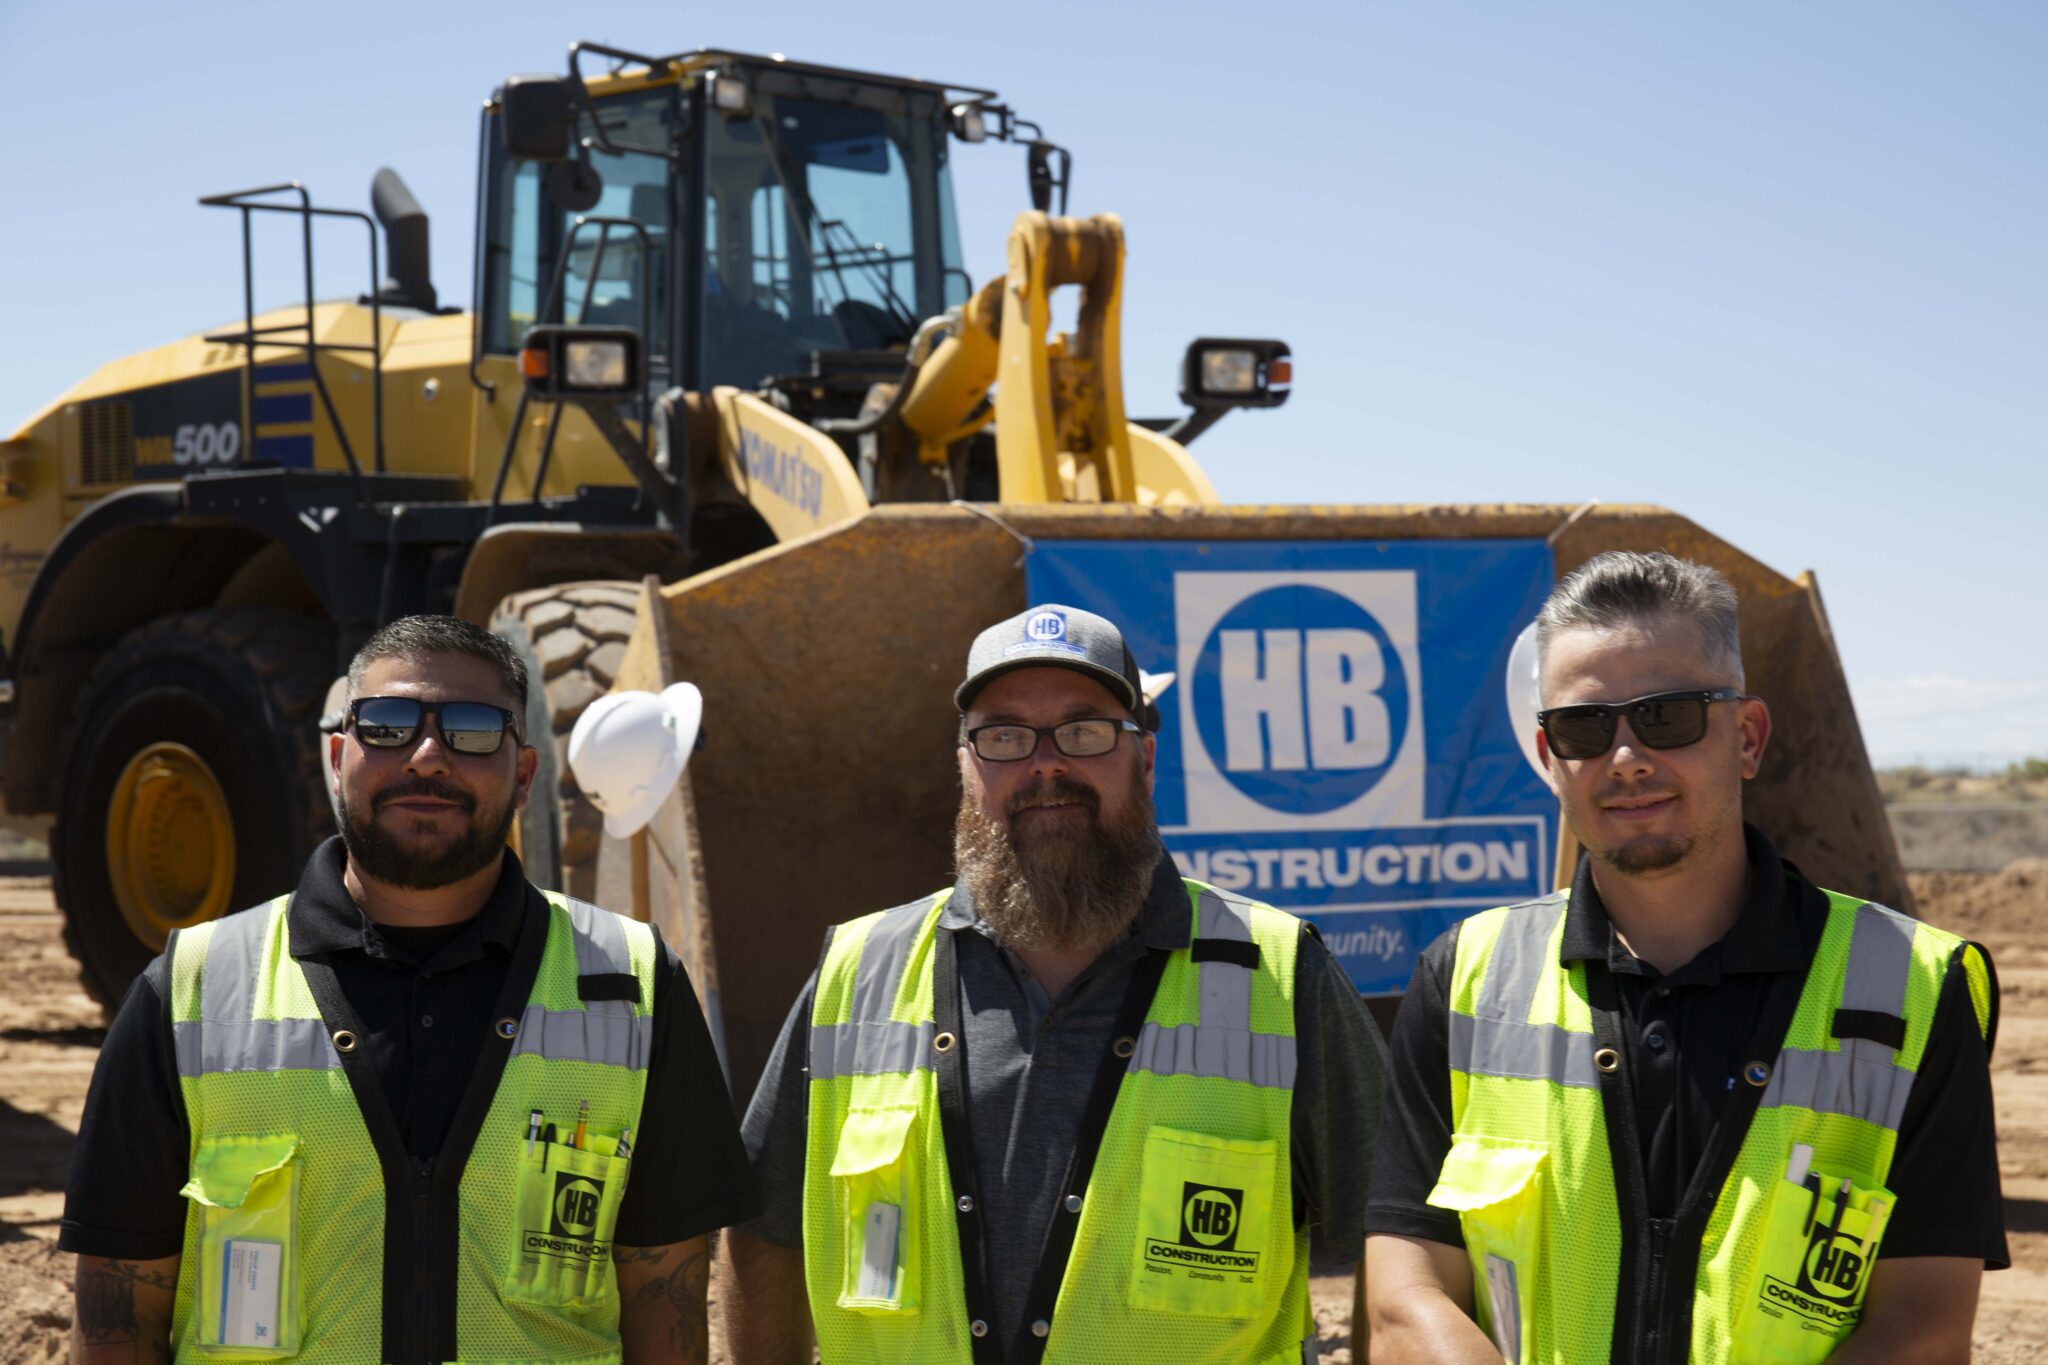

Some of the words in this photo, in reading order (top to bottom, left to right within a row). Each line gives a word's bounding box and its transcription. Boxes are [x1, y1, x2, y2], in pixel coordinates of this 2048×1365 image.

[1034, 618, 1060, 635] HB
[1219, 628, 1391, 772] HB
[1169, 841, 1529, 890] NSTRUCTION
[562, 1188, 599, 1228] HB
[1192, 1198, 1232, 1236] HB
[1150, 1245, 1255, 1267] CONSTRUCTION
[1812, 1242, 1862, 1291] HB
